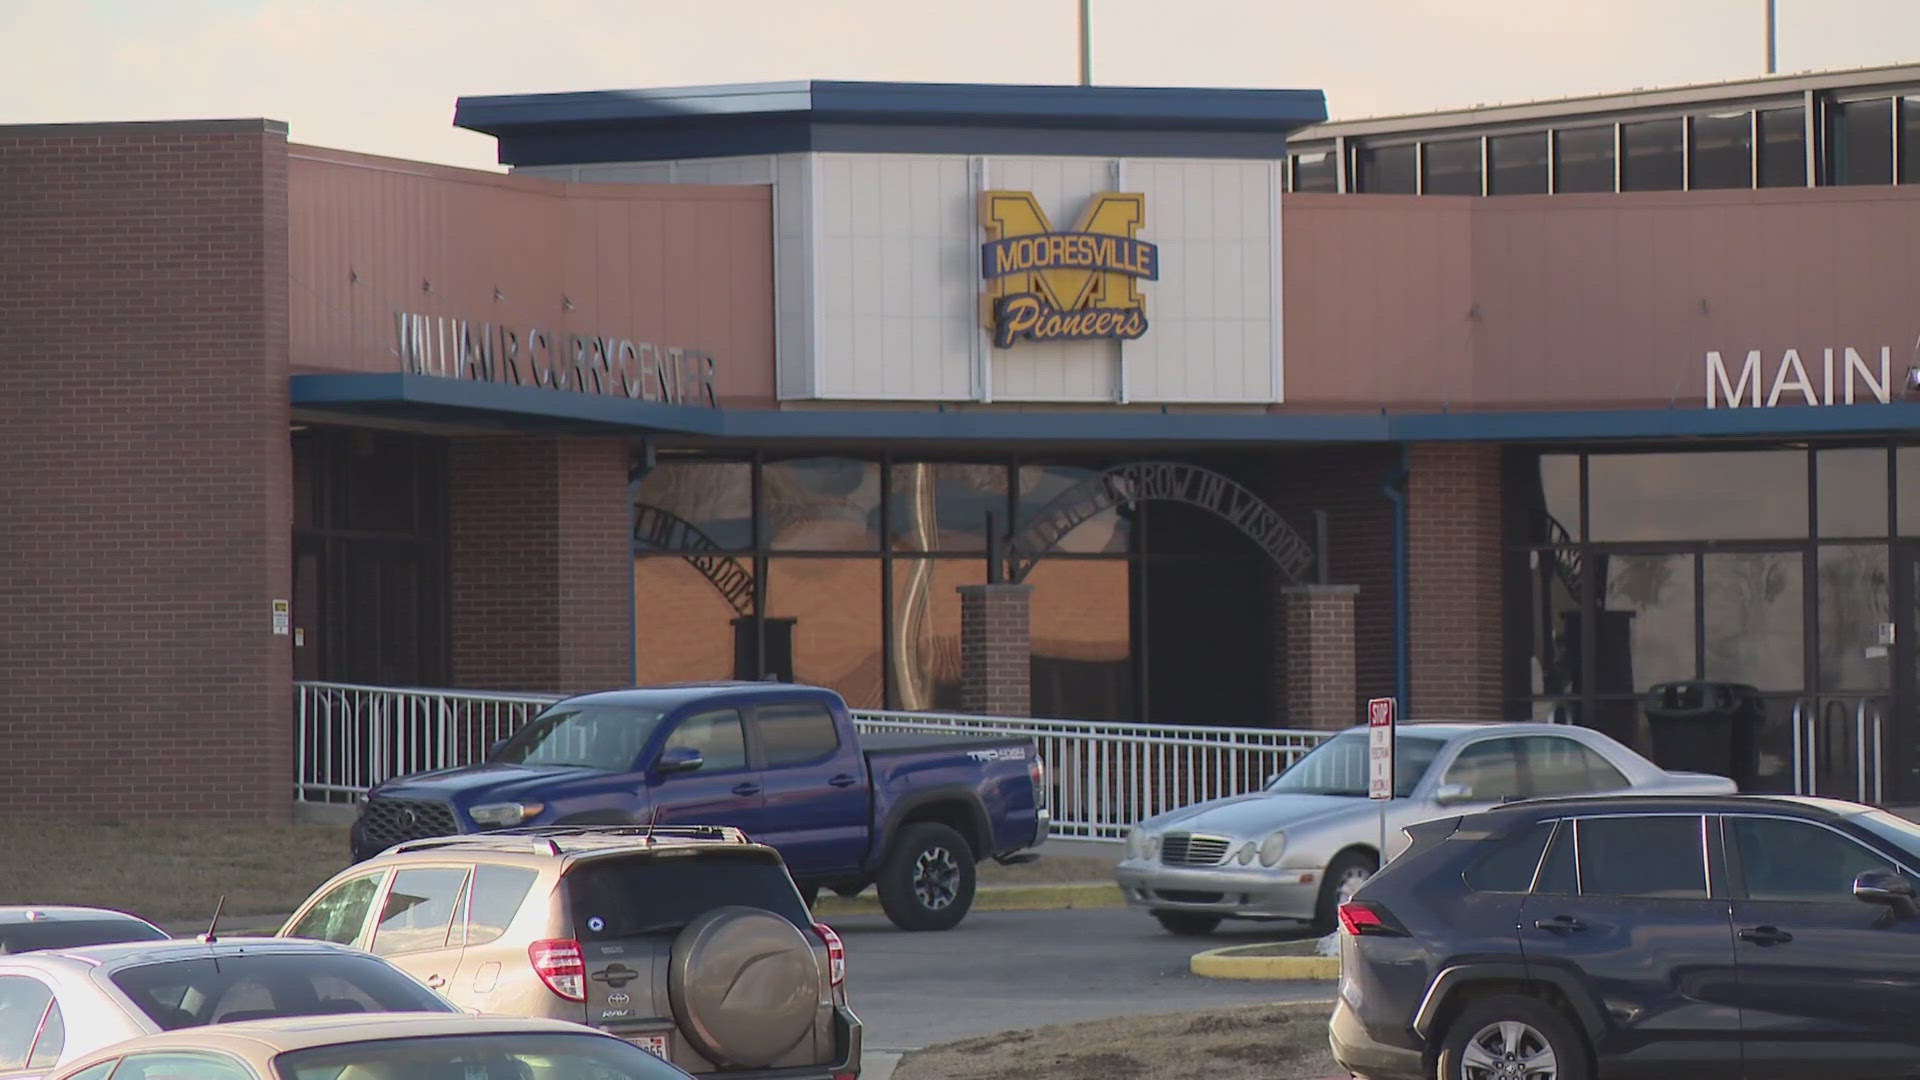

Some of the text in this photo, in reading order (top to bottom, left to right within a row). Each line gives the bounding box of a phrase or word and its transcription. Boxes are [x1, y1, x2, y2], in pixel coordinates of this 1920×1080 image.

[996, 235, 1151, 276] MOORESVILLE
[1006, 297, 1146, 345] Pioneers
[529, 328, 616, 397] CURRY
[618, 338, 716, 410] CENTER
[1706, 346, 1891, 410] MAIN
